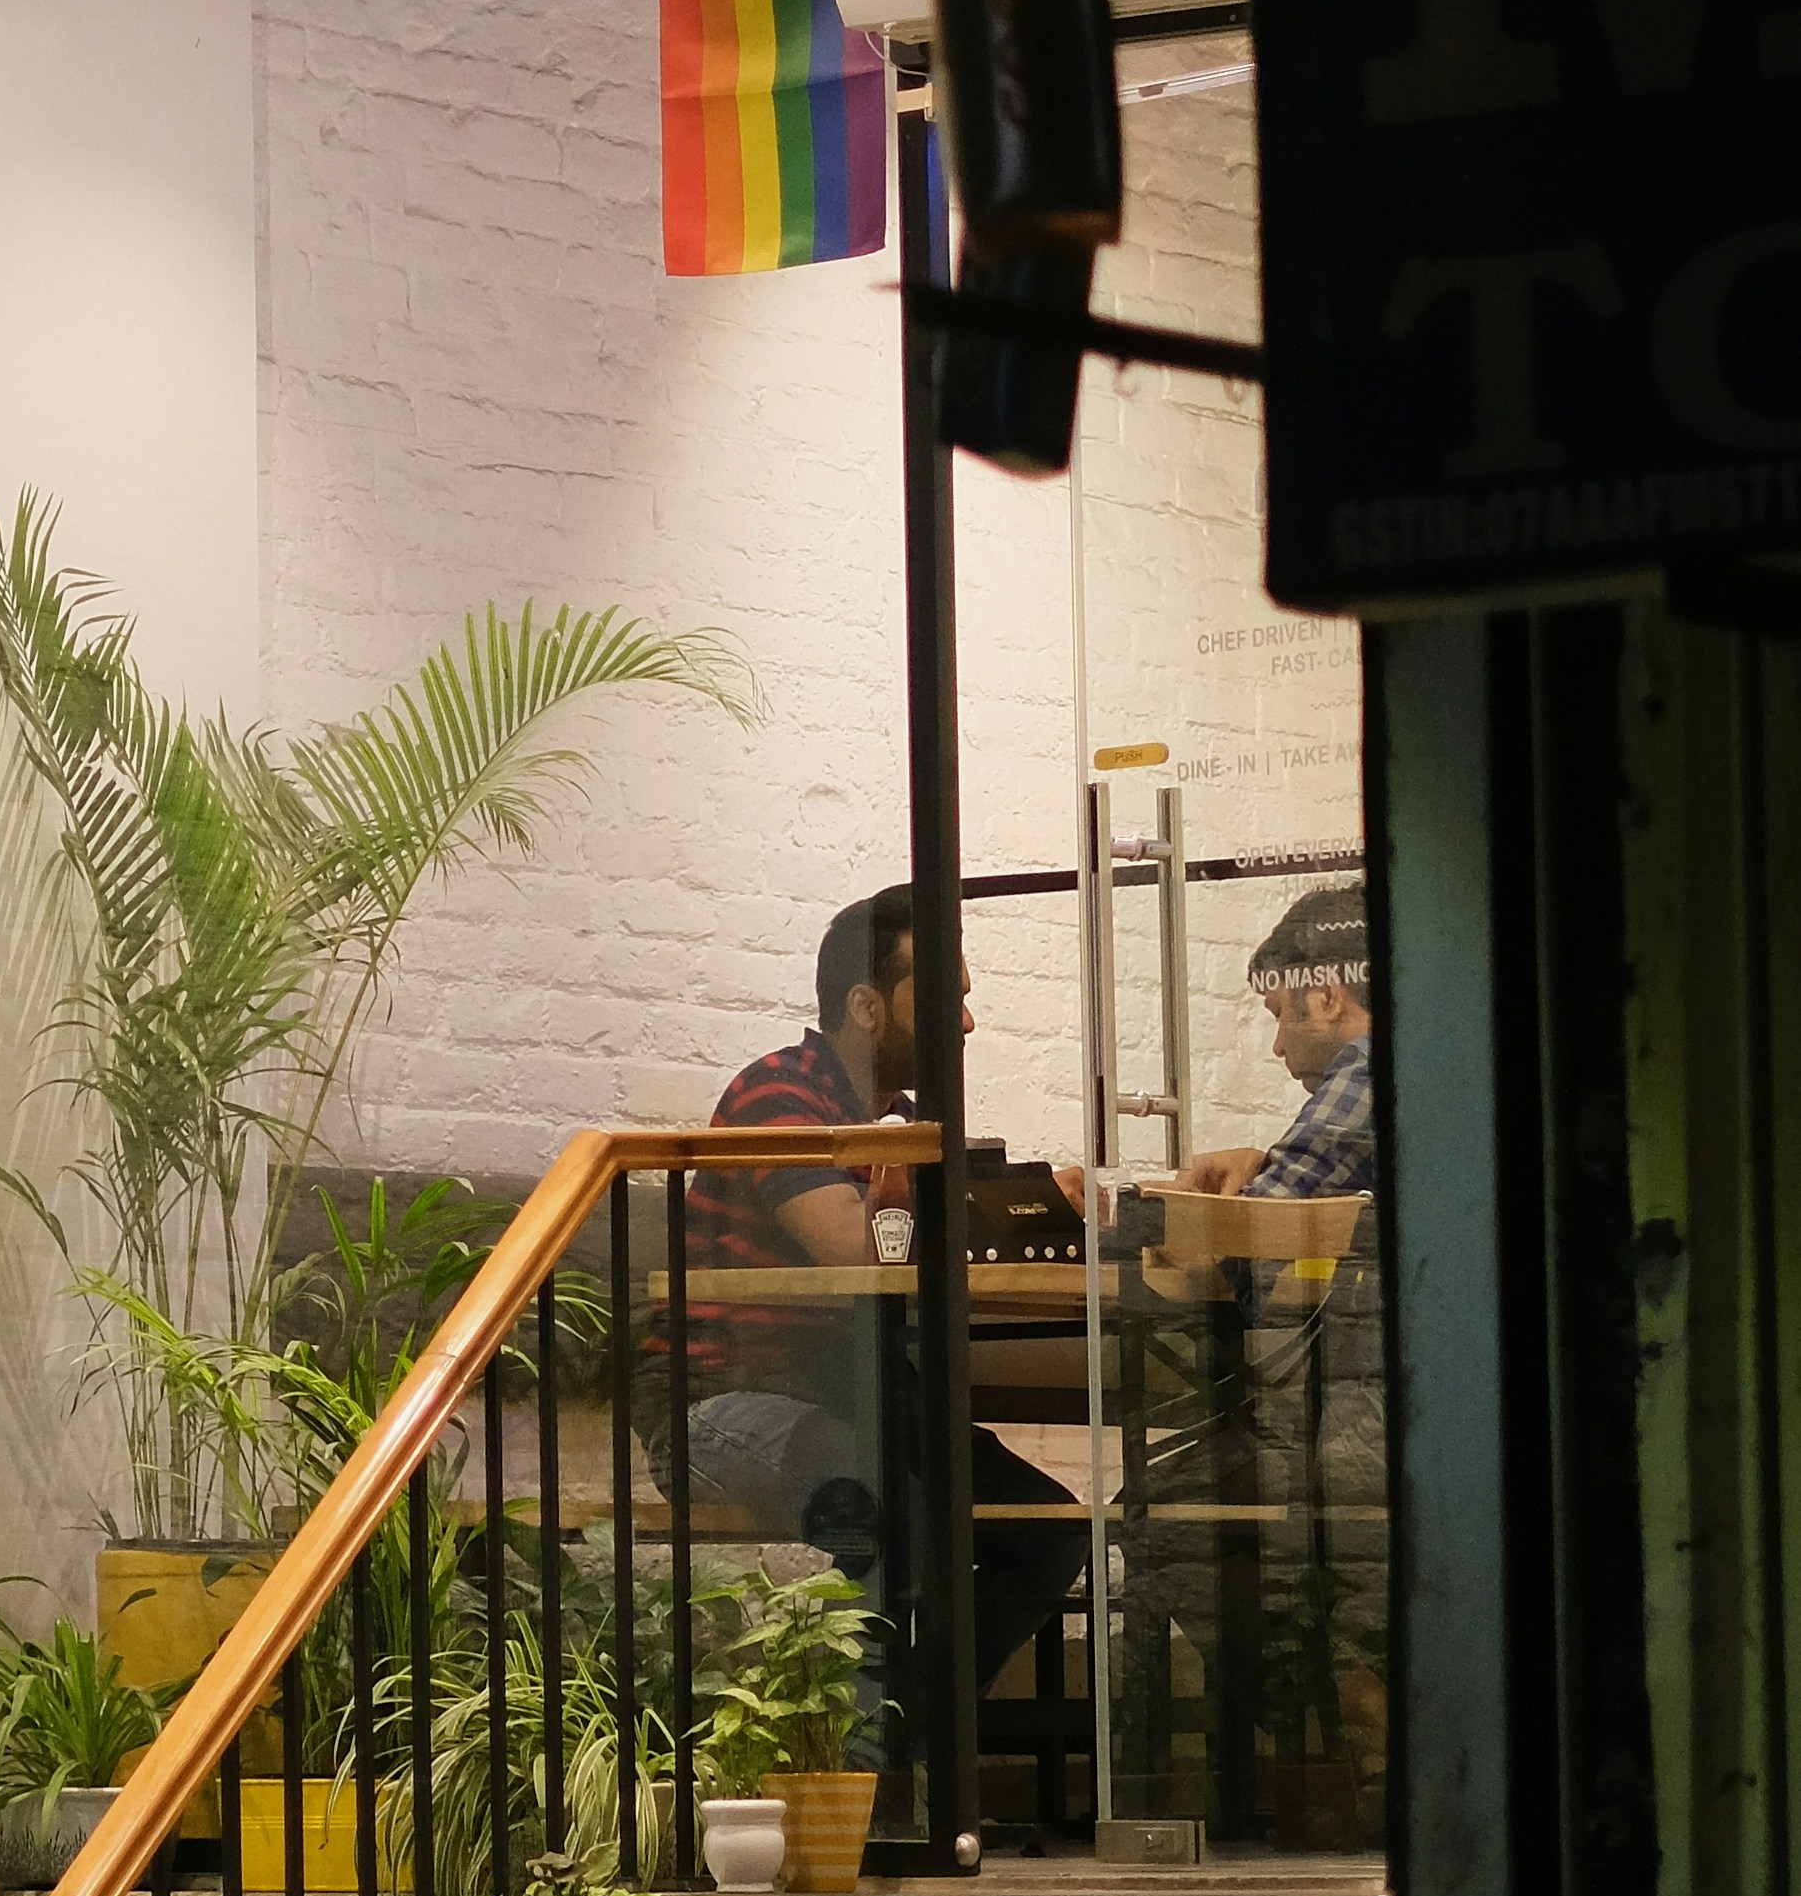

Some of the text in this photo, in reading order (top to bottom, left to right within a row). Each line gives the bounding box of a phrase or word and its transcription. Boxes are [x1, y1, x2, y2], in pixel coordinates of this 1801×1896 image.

[1197, 620, 1323, 654] CHEF DRIVEN
[1327, 648, 1362, 670] CA
[1281, 744, 1331, 768] TAKE
[1235, 844, 1288, 869] OPEN
[1251, 970, 1280, 992] NO
[1285, 964, 1341, 989] MASK
